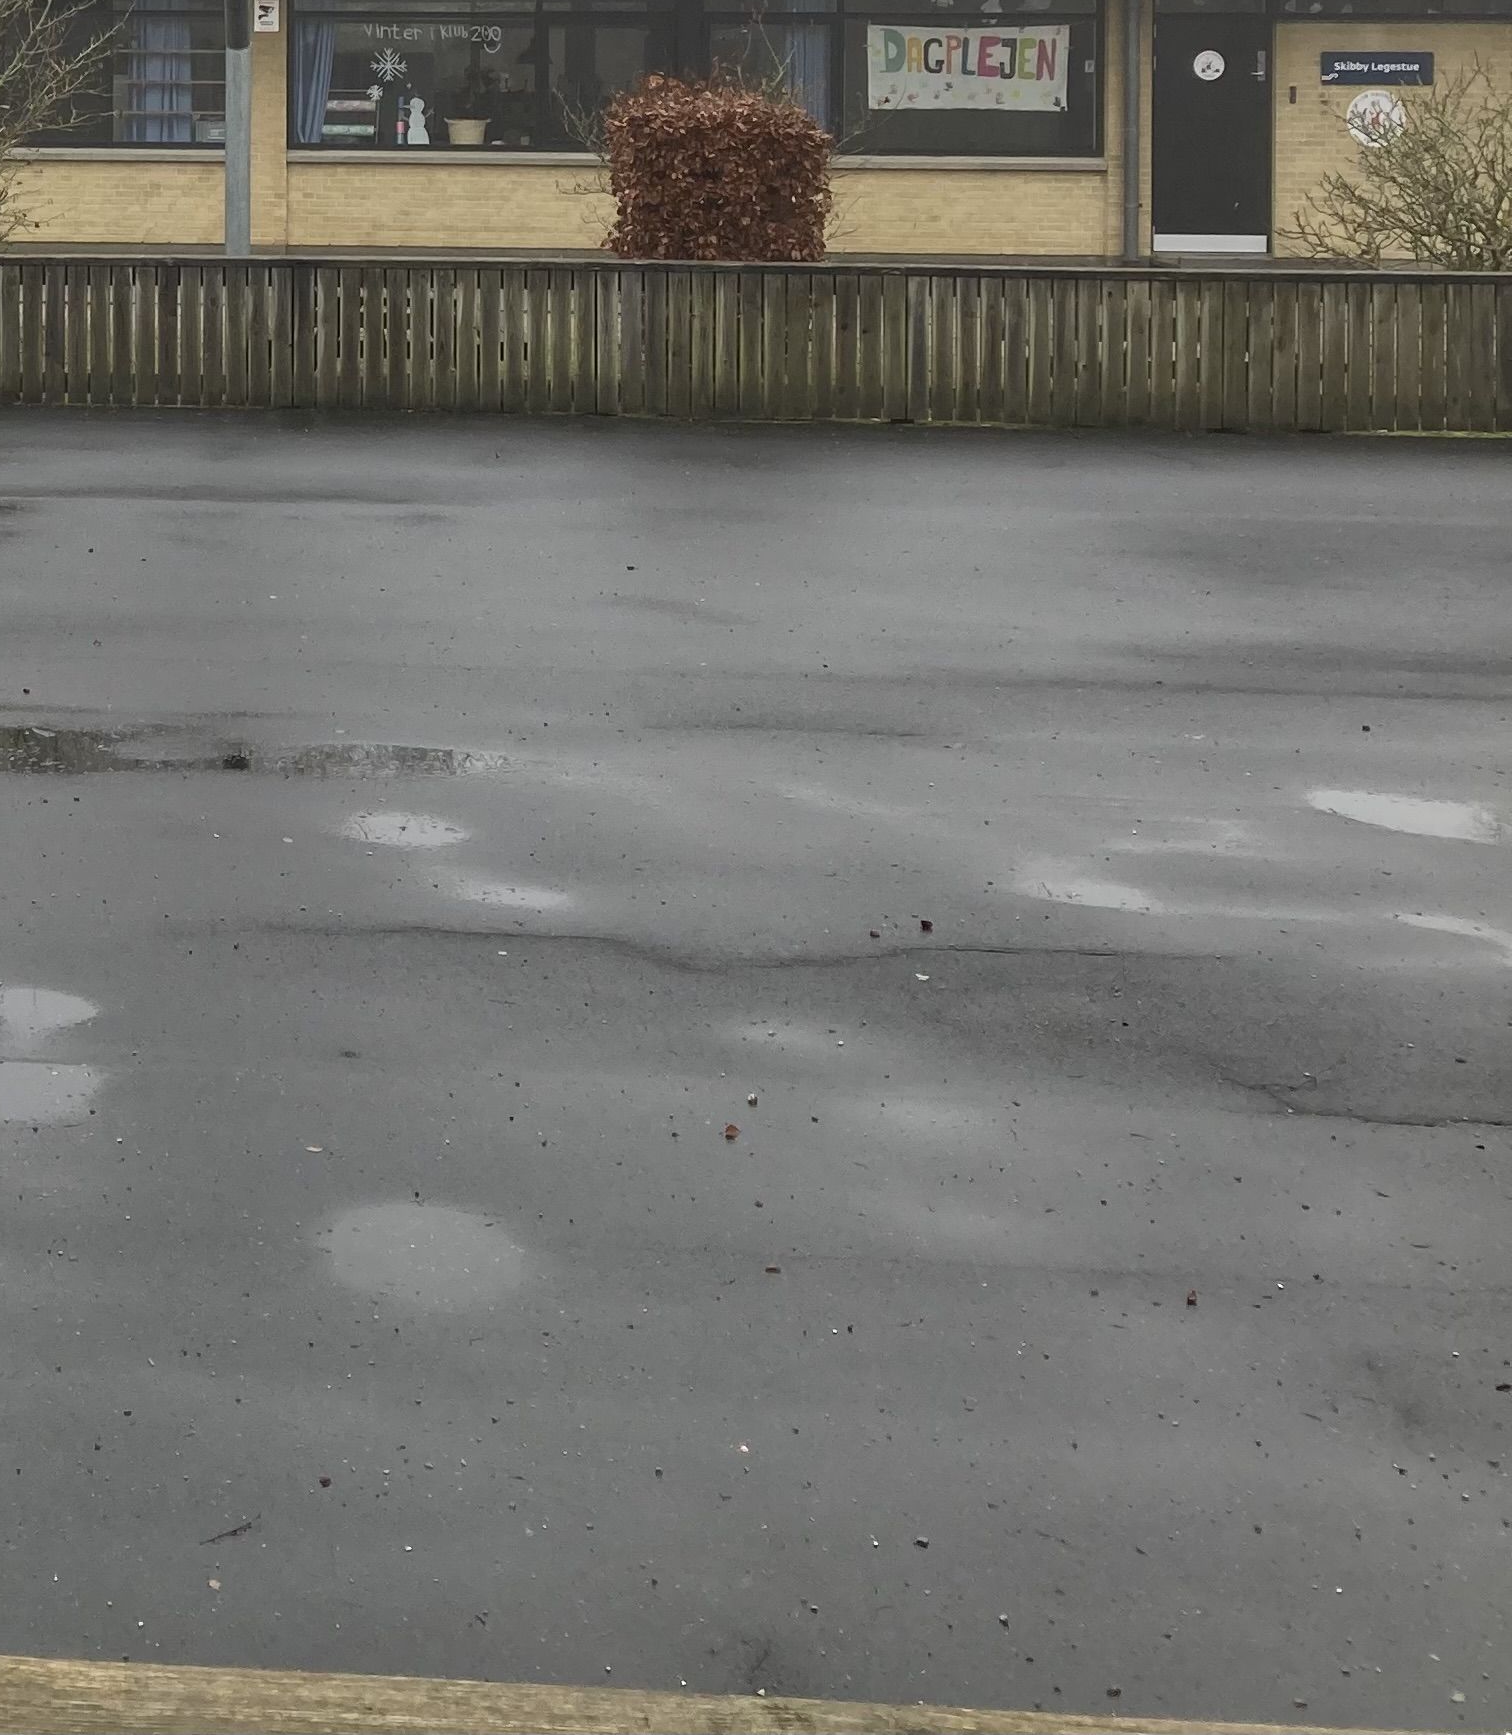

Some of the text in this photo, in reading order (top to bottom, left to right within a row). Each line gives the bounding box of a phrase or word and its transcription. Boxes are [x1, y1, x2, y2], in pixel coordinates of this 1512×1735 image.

[880, 28, 1056, 80] DAGPLEJEN
[1333, 61, 1420, 74] Skibby Legestue
